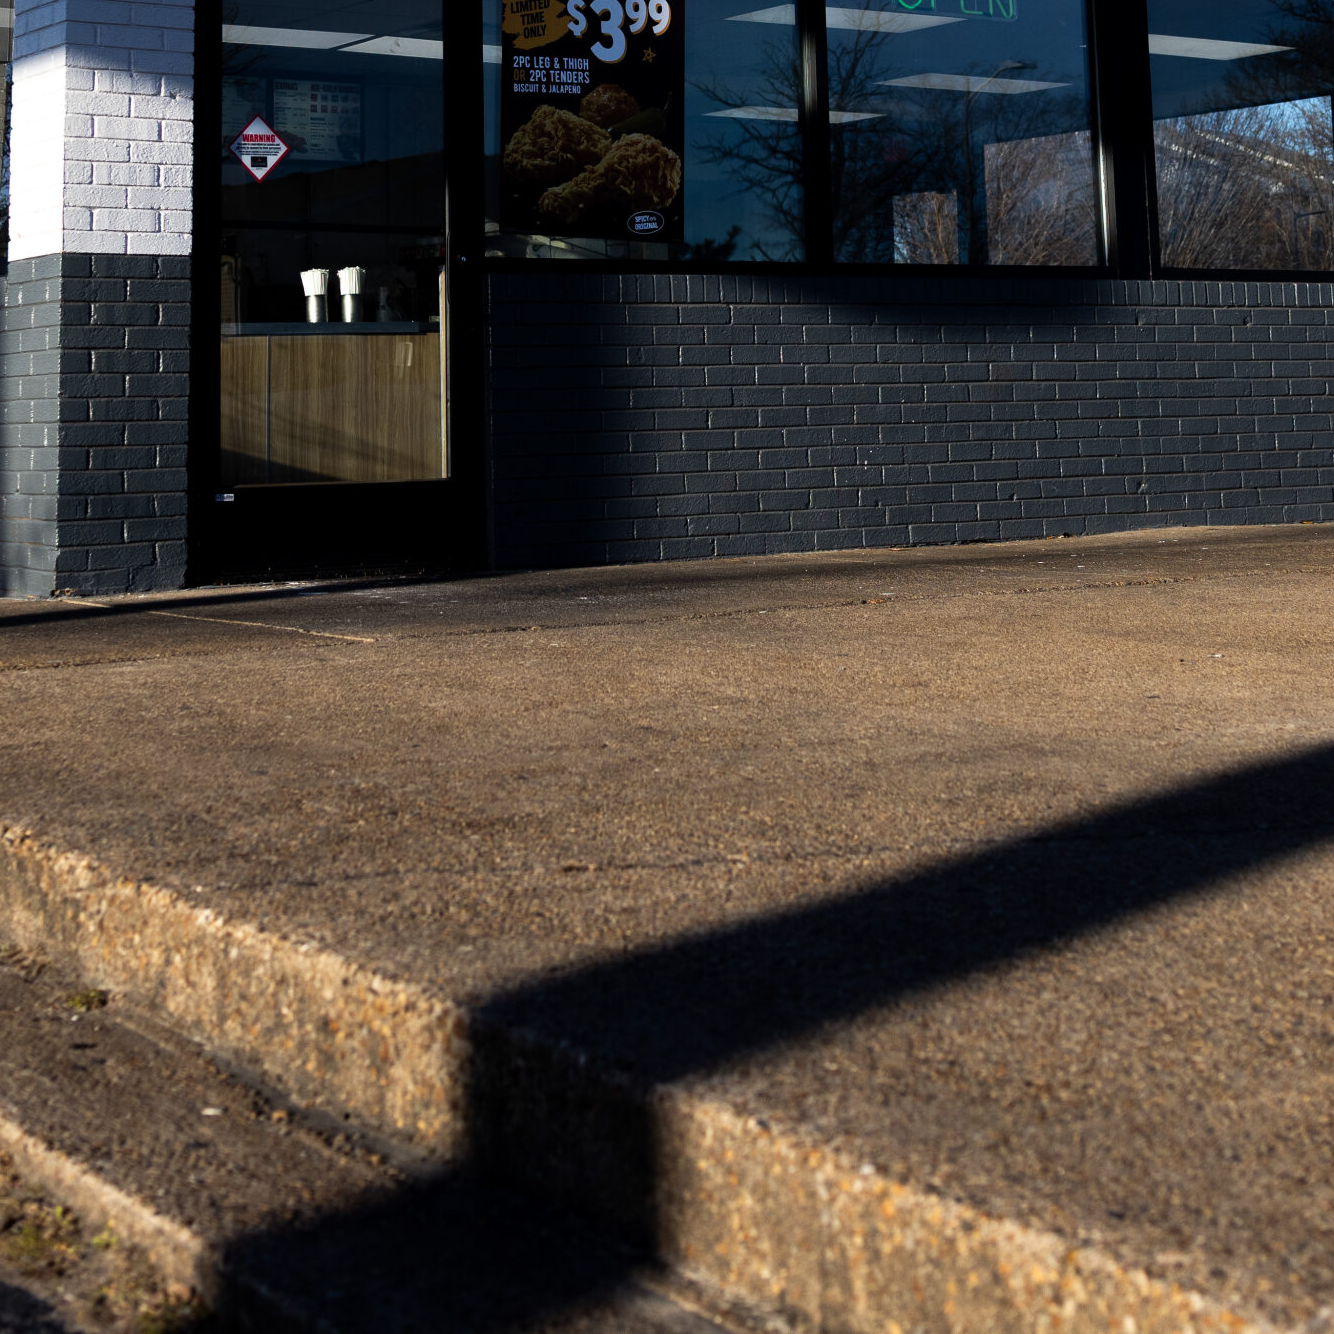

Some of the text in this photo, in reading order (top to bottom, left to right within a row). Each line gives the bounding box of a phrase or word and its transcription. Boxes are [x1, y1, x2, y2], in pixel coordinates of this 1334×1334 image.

[520, 11, 545, 26] TIME
[523, 25, 547, 39] ONLY
[513, 55, 589, 71] 2PC LEG & THIGH
[513, 68, 590, 84] OR 2PC TENDERS
[513, 82, 539, 93] BISCUIT
[541, 84, 547, 93] &
[242, 133, 276, 143] WARNING
